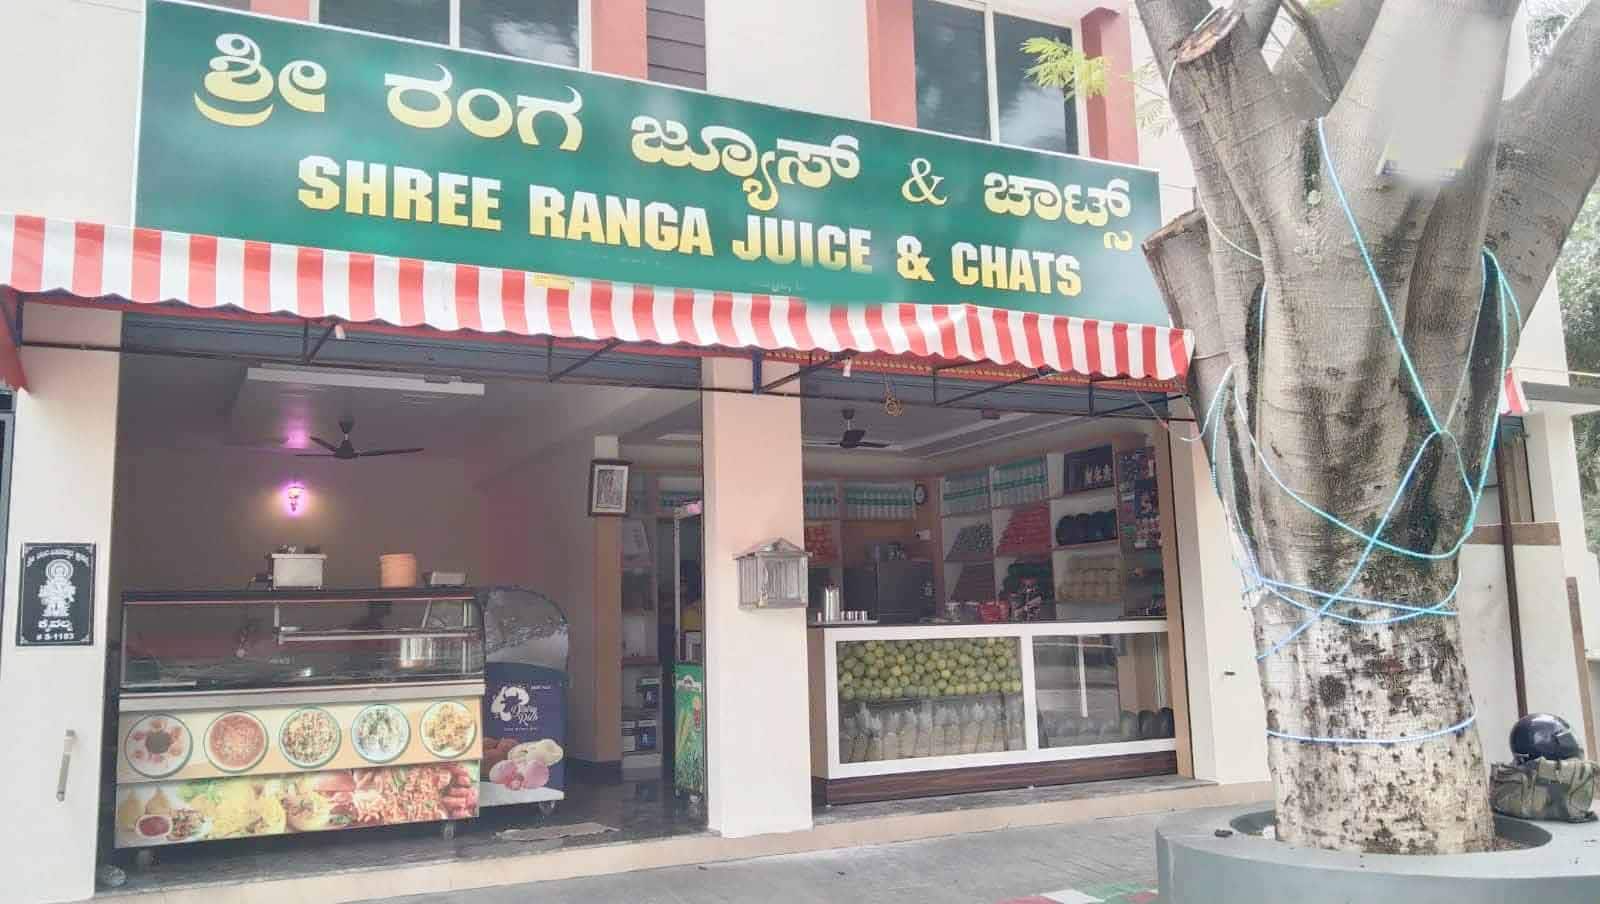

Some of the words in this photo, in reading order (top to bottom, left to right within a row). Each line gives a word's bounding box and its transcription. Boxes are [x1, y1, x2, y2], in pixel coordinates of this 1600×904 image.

[194, 33, 327, 127] ಶ್ರೀ
[384, 64, 583, 151] ರಂಗ
[631, 115, 860, 211] ಜ್ಯೂಸ್
[902, 158, 948, 206] &
[984, 172, 1133, 251] ಚಾಟ್ಸ್
[298, 155, 502, 232] SHREE
[529, 185, 714, 257] RANGA
[732, 214, 873, 274] JUICE
[897, 235, 935, 282] &
[951, 241, 1081, 297] CHATS
